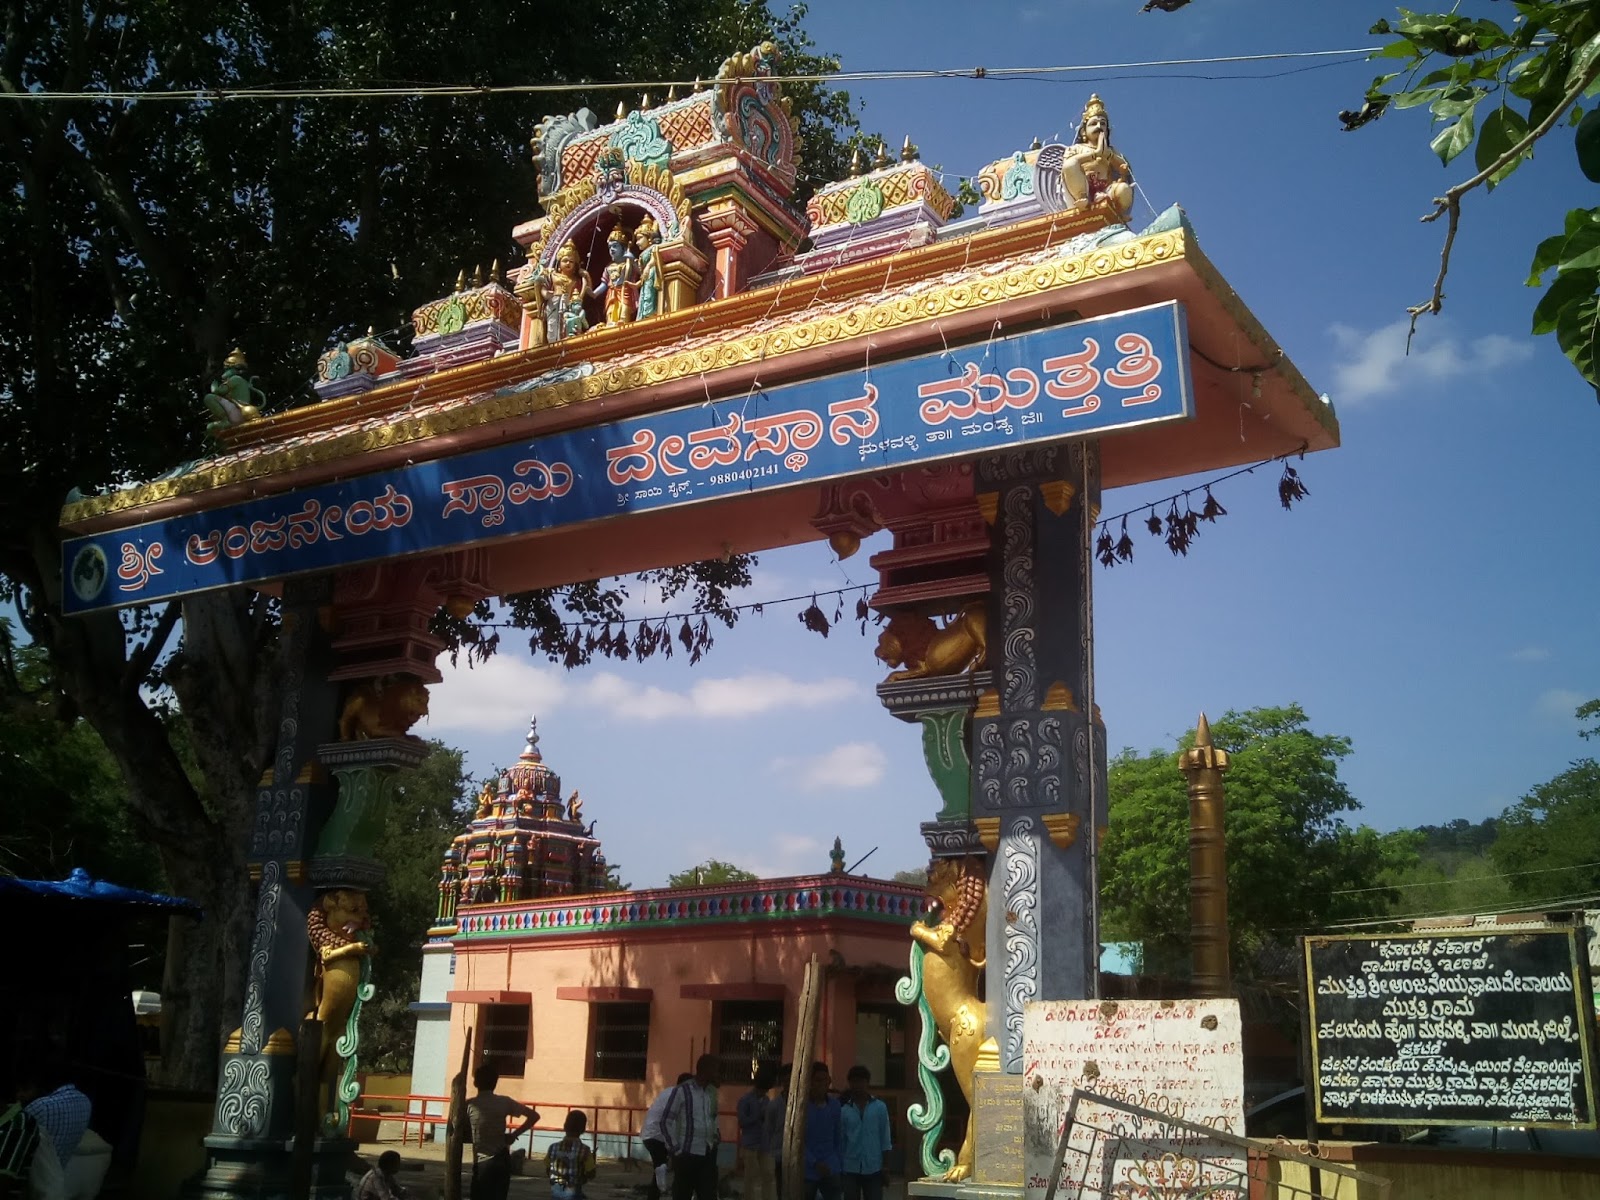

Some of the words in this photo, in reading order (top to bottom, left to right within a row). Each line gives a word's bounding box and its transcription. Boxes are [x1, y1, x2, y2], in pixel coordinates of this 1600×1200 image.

[118, 542, 163, 591] ಶ್ರೀ
[186, 484, 413, 565] ಆಂಜನೇಯ
[442, 455, 574, 527] ಸ್ವಾಮಿ
[606, 383, 879, 486] ದೇವಸ್ಥಾನ
[918, 333, 1162, 425] ಮುತ್ತತ್ತಿ
[710, 464, 779, 486] 9880402141
